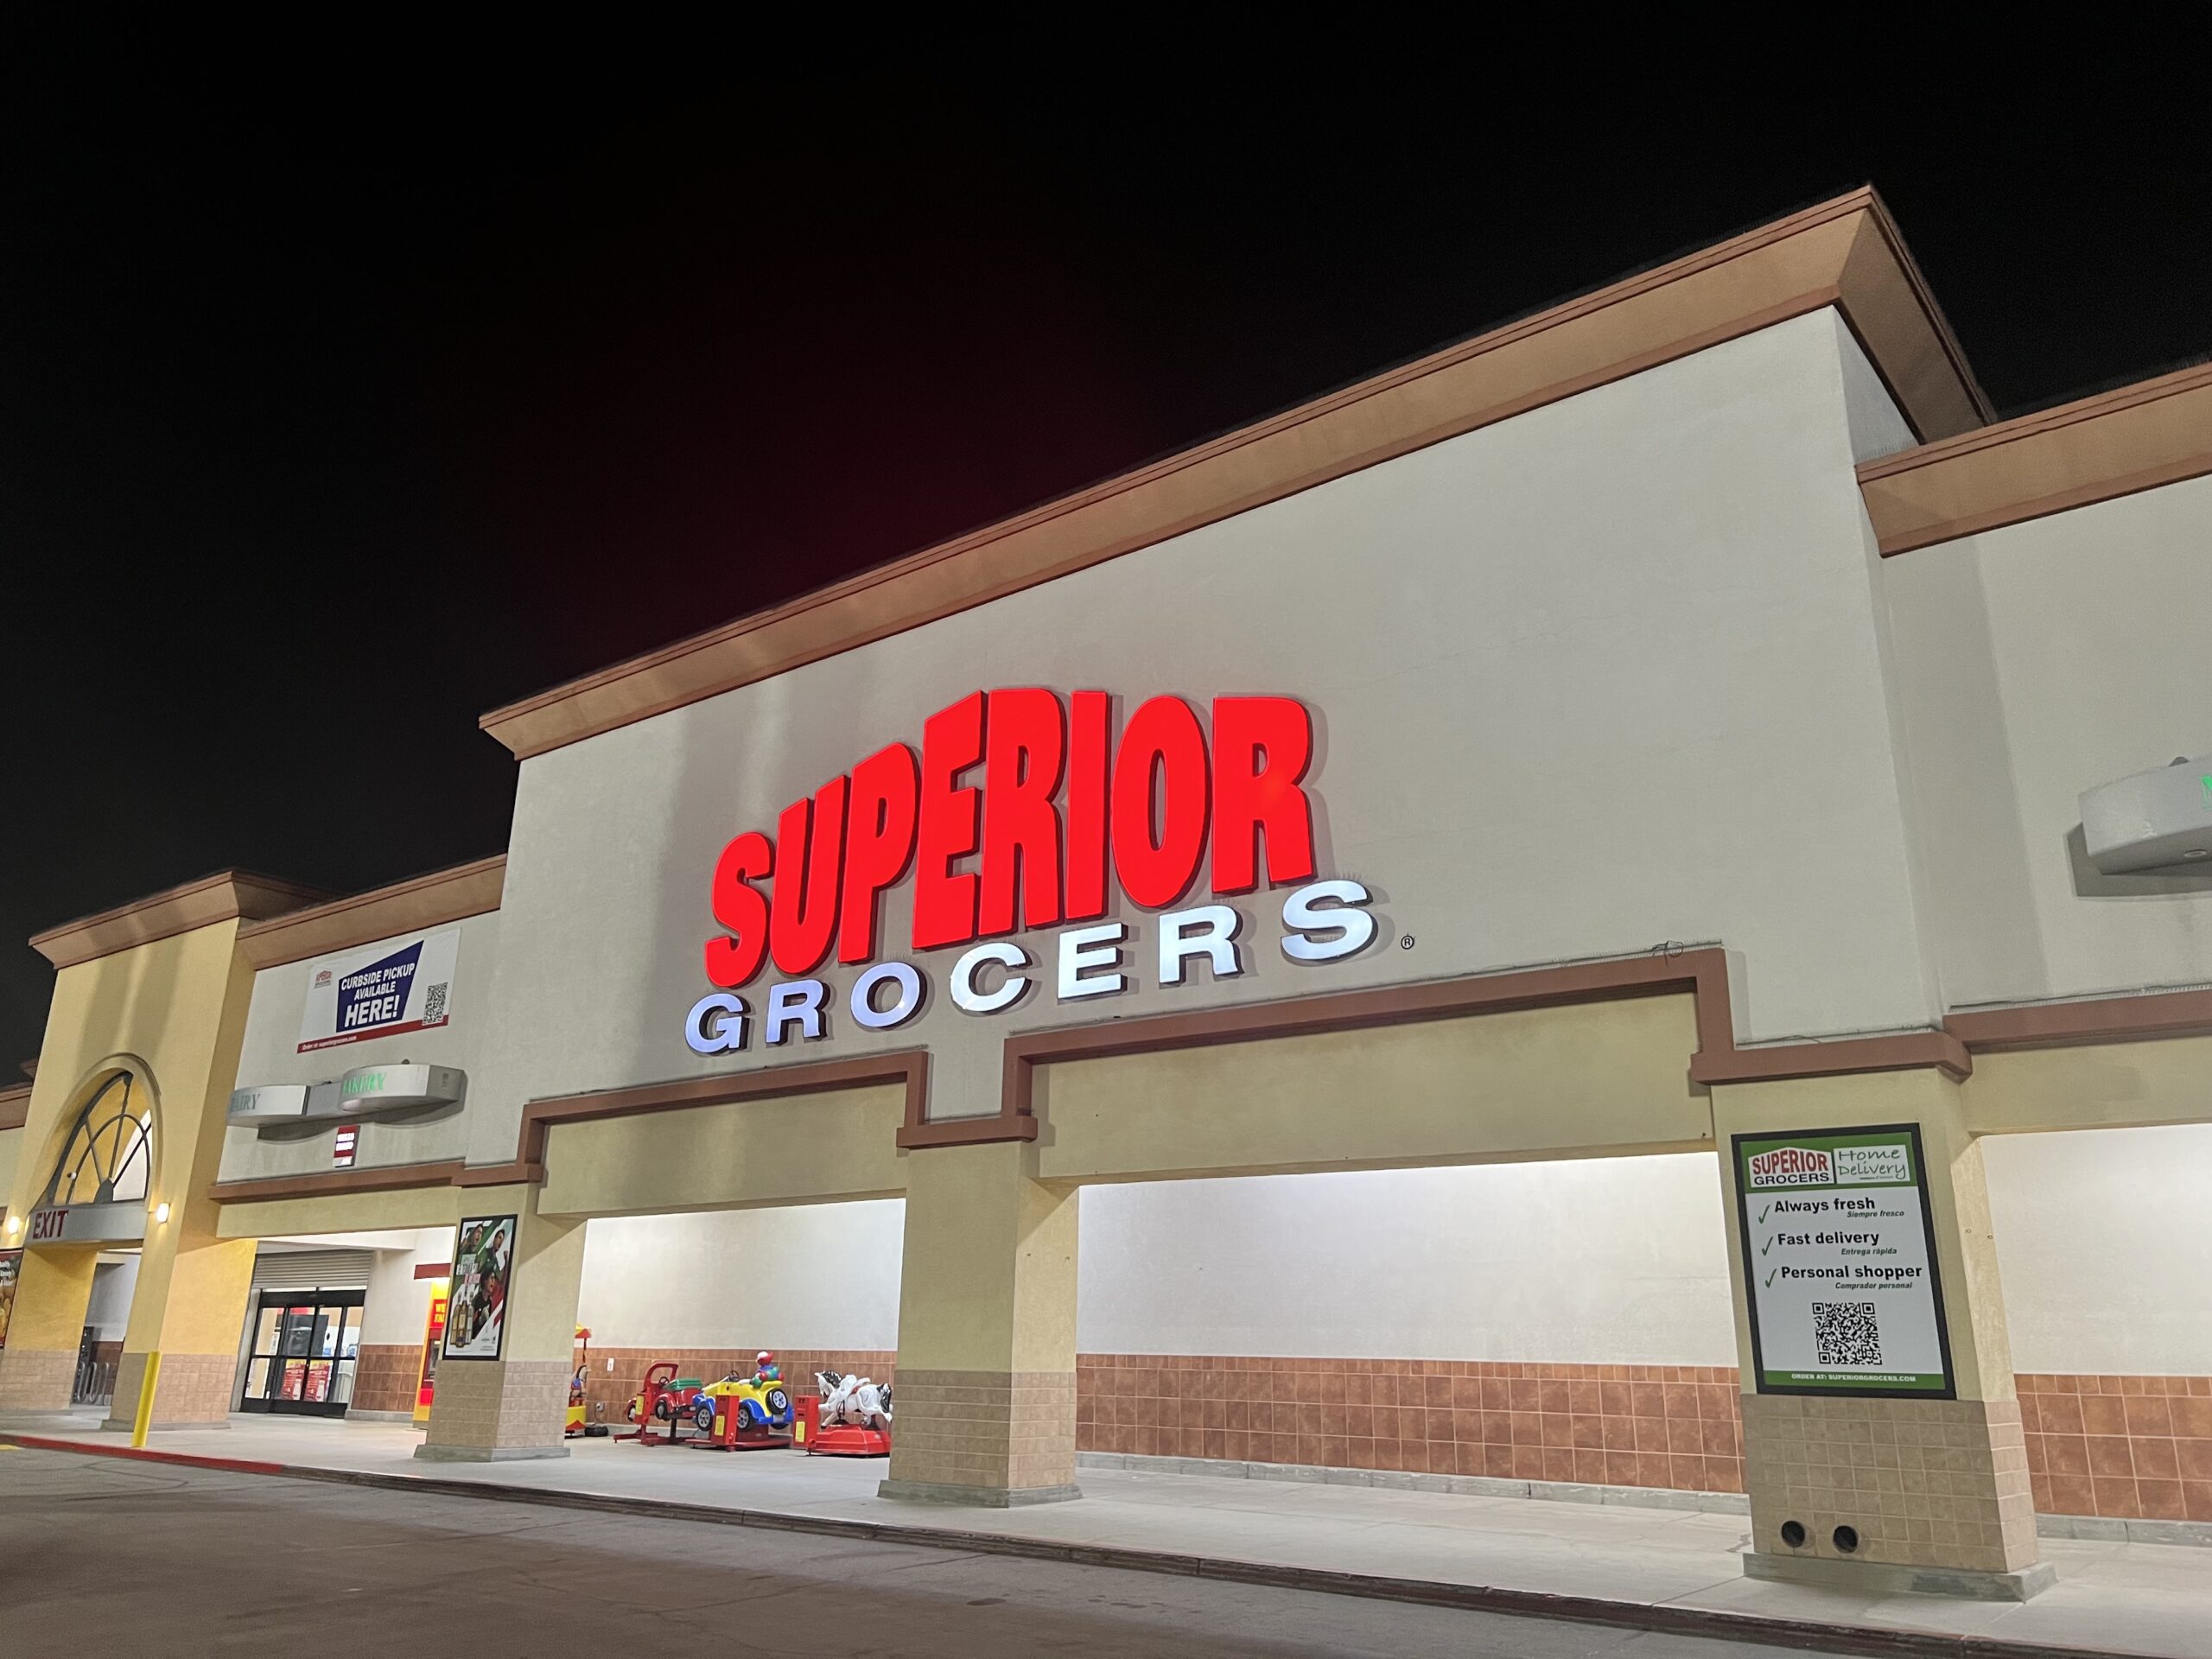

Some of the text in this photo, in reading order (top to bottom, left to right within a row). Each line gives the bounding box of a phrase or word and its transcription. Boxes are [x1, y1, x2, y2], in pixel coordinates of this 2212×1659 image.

[704, 688, 1319, 988] SUPERIOR
[684, 879, 1379, 1055] GROCERS
[341, 970, 382, 991] CURBSIDE
[383, 963, 416, 982] PICKUP
[354, 981, 397, 1001] AVAILABLE
[344, 995, 401, 1028] HERE!
[1752, 1149, 1829, 1175] SUPERIOR
[1839, 1148, 1901, 1162] Home
[1754, 1172, 1830, 1185] GROCERS
[1838, 1160, 1907, 1180] Delivery
[1774, 1197, 1876, 1214] Always fresh
[1847, 1211, 1878, 1219] Siempre
[33, 1210, 69, 1240] EXIT
[1777, 1231, 1880, 1247] Fast delivery
[1840, 1248, 1872, 1256] Entrega
[1781, 1265, 1923, 1281] Personal shopper
[1834, 1281, 1913, 1290] Comprador personal
